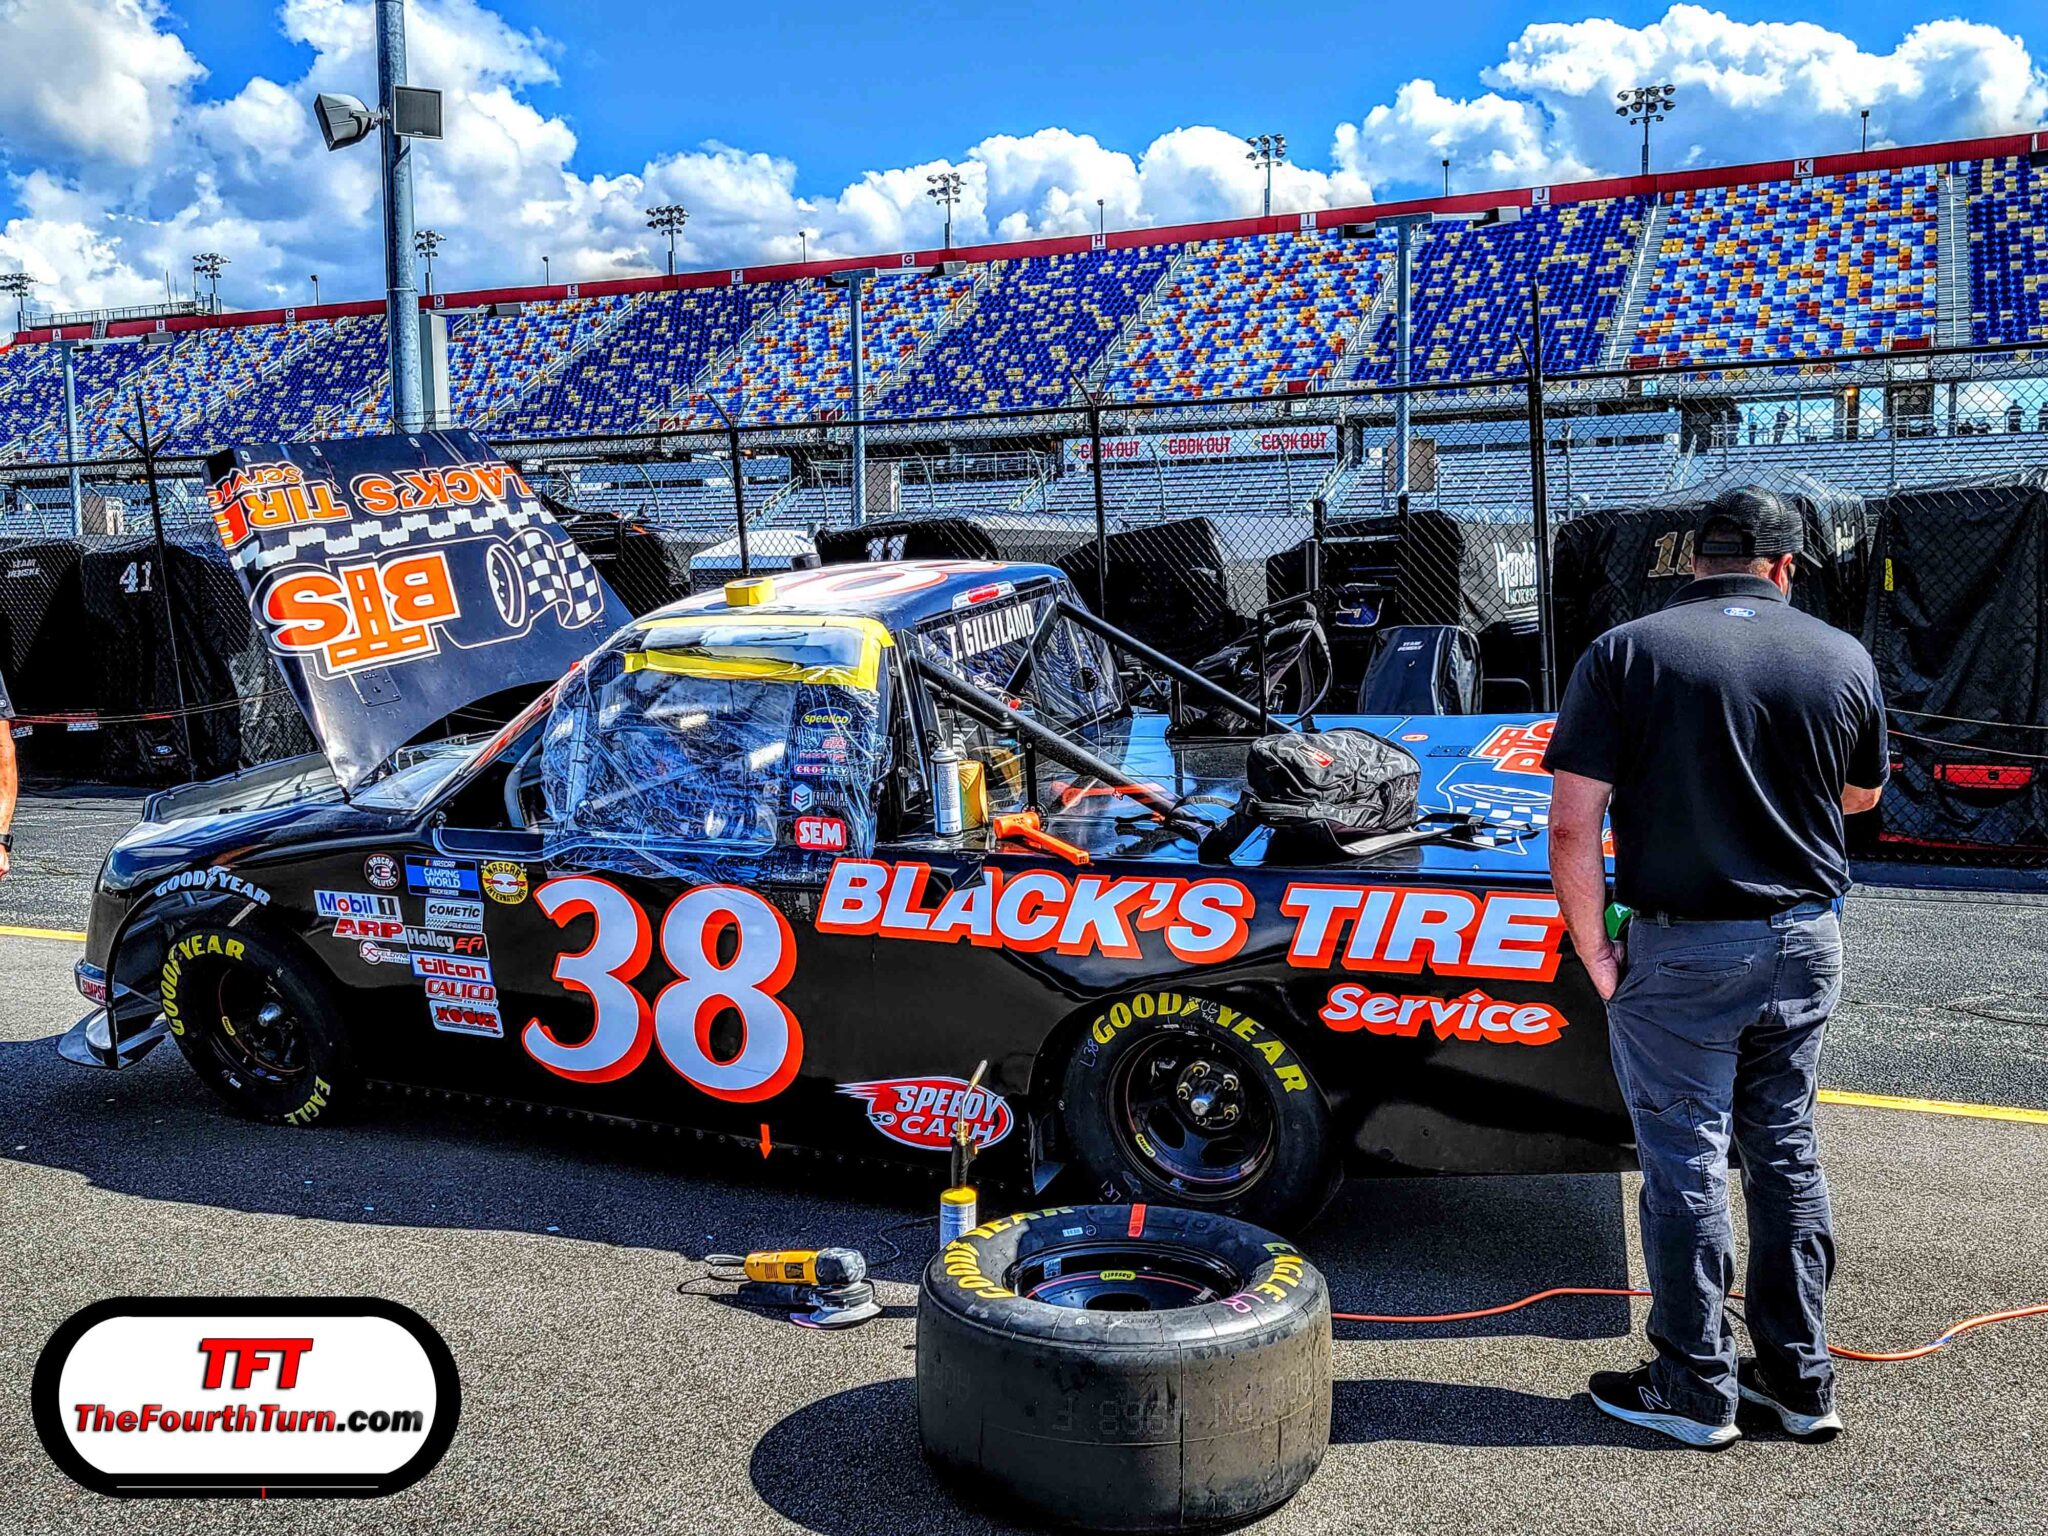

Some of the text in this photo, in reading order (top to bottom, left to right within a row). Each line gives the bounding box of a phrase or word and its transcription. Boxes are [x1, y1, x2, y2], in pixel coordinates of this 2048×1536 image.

[1798, 161, 1809, 173] K
[1536, 188, 1546, 200] J
[903, 255, 913, 264] G
[1081, 441, 1141, 460] COK OUT
[1168, 436, 1231, 455] COOK OUT
[1261, 432, 1327, 450] COOK OUT
[207, 465, 303, 508] Servic
[354, 463, 534, 514] LACK'S
[214, 482, 352, 550] TIRE
[119, 561, 152, 593] 41
[263, 552, 460, 674] BTS
[962, 604, 1035, 657] GILLILAND
[804, 713, 849, 727] speedco
[797, 765, 848, 775] CROSLEY
[799, 822, 843, 846] SEM
[368, 857, 394, 869] NASCAR
[424, 868, 460, 879] CAMPING
[432, 860, 456, 868] NASCAR
[487, 862, 522, 878] NASCAR
[154, 866, 271, 906] GOODYEAR
[369, 875, 397, 887] SALUTES
[425, 876, 461, 888] WORLD
[319, 892, 373, 914] Mobil
[429, 903, 481, 918] COMETIC
[816, 858, 1255, 964] BLACK'S
[335, 919, 403, 938] ARP
[1280, 882, 1566, 983] TIRE
[407, 929, 454, 953] Holley
[417, 957, 487, 980] tilton
[82, 980, 106, 1000] SIMPSO
[161, 935, 245, 1036] GOODYEAR
[427, 980, 495, 1001] CALICO
[522, 876, 803, 1103] 38
[1319, 982, 1569, 1046] Service
[1093, 992, 1308, 1093] GOODYEAR
[284, 1076, 331, 1125] EAGLE
[893, 1085, 1005, 1122] SPEEDY
[872, 1113, 893, 1123] SC
[944, 1206, 1074, 1299] GOODYEAR
[1263, 1242, 1303, 1303] EAGLE
